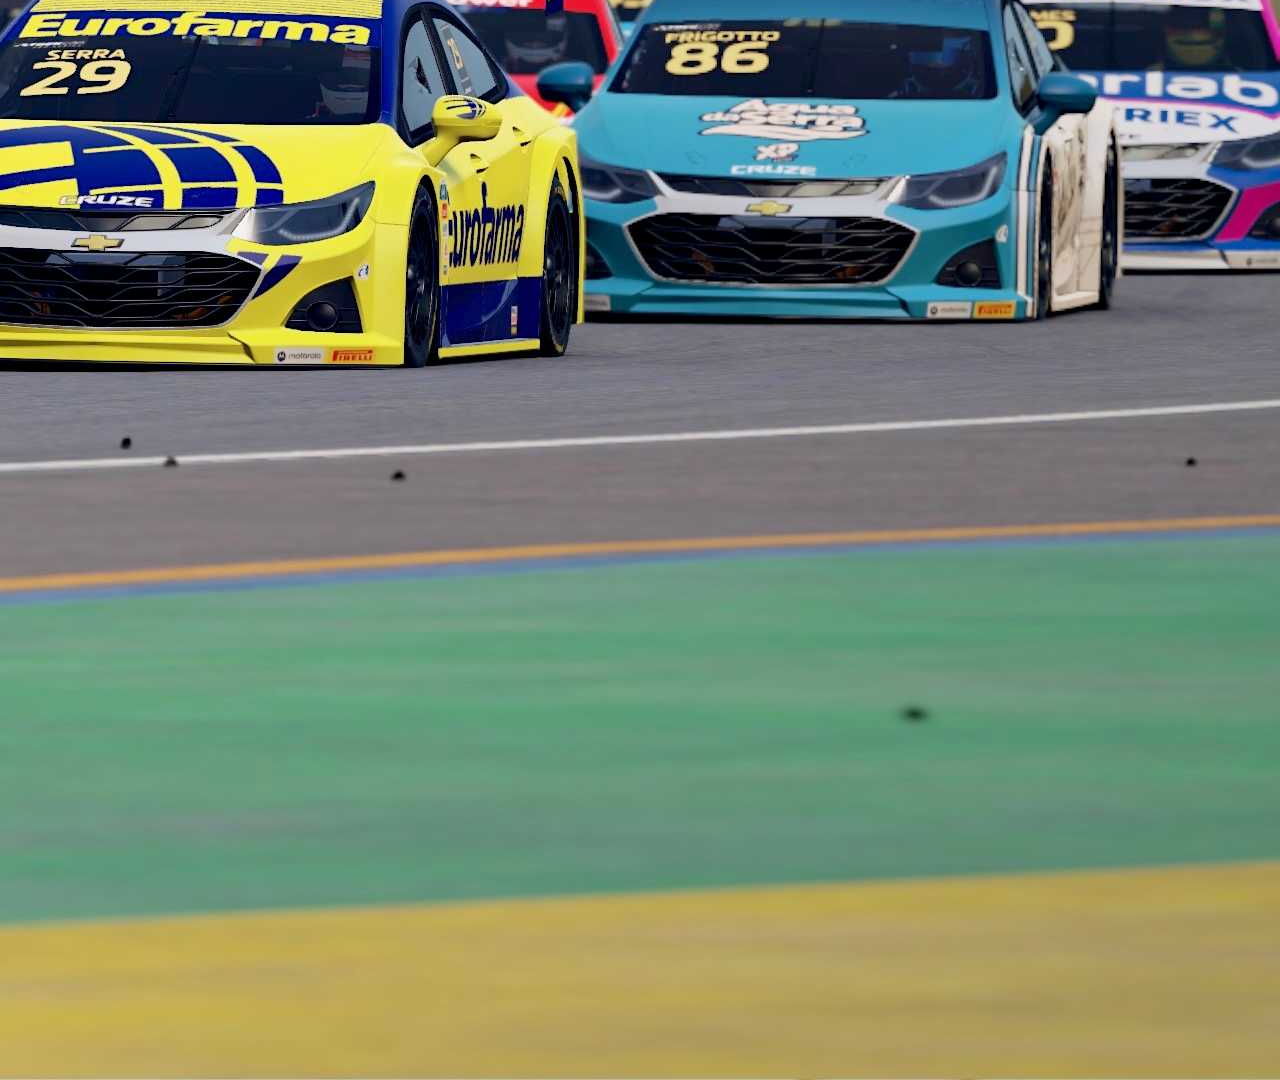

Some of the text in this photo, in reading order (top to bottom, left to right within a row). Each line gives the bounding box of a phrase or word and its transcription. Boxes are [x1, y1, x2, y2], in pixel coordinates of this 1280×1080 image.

[18, 12, 371, 45] Eurofarma
[45, 48, 126, 61] SERRA
[665, 41, 770, 75] 86
[19, 60, 132, 97] 29
[731, 165, 817, 176] CRUZE
[59, 194, 154, 208] CRUZE
